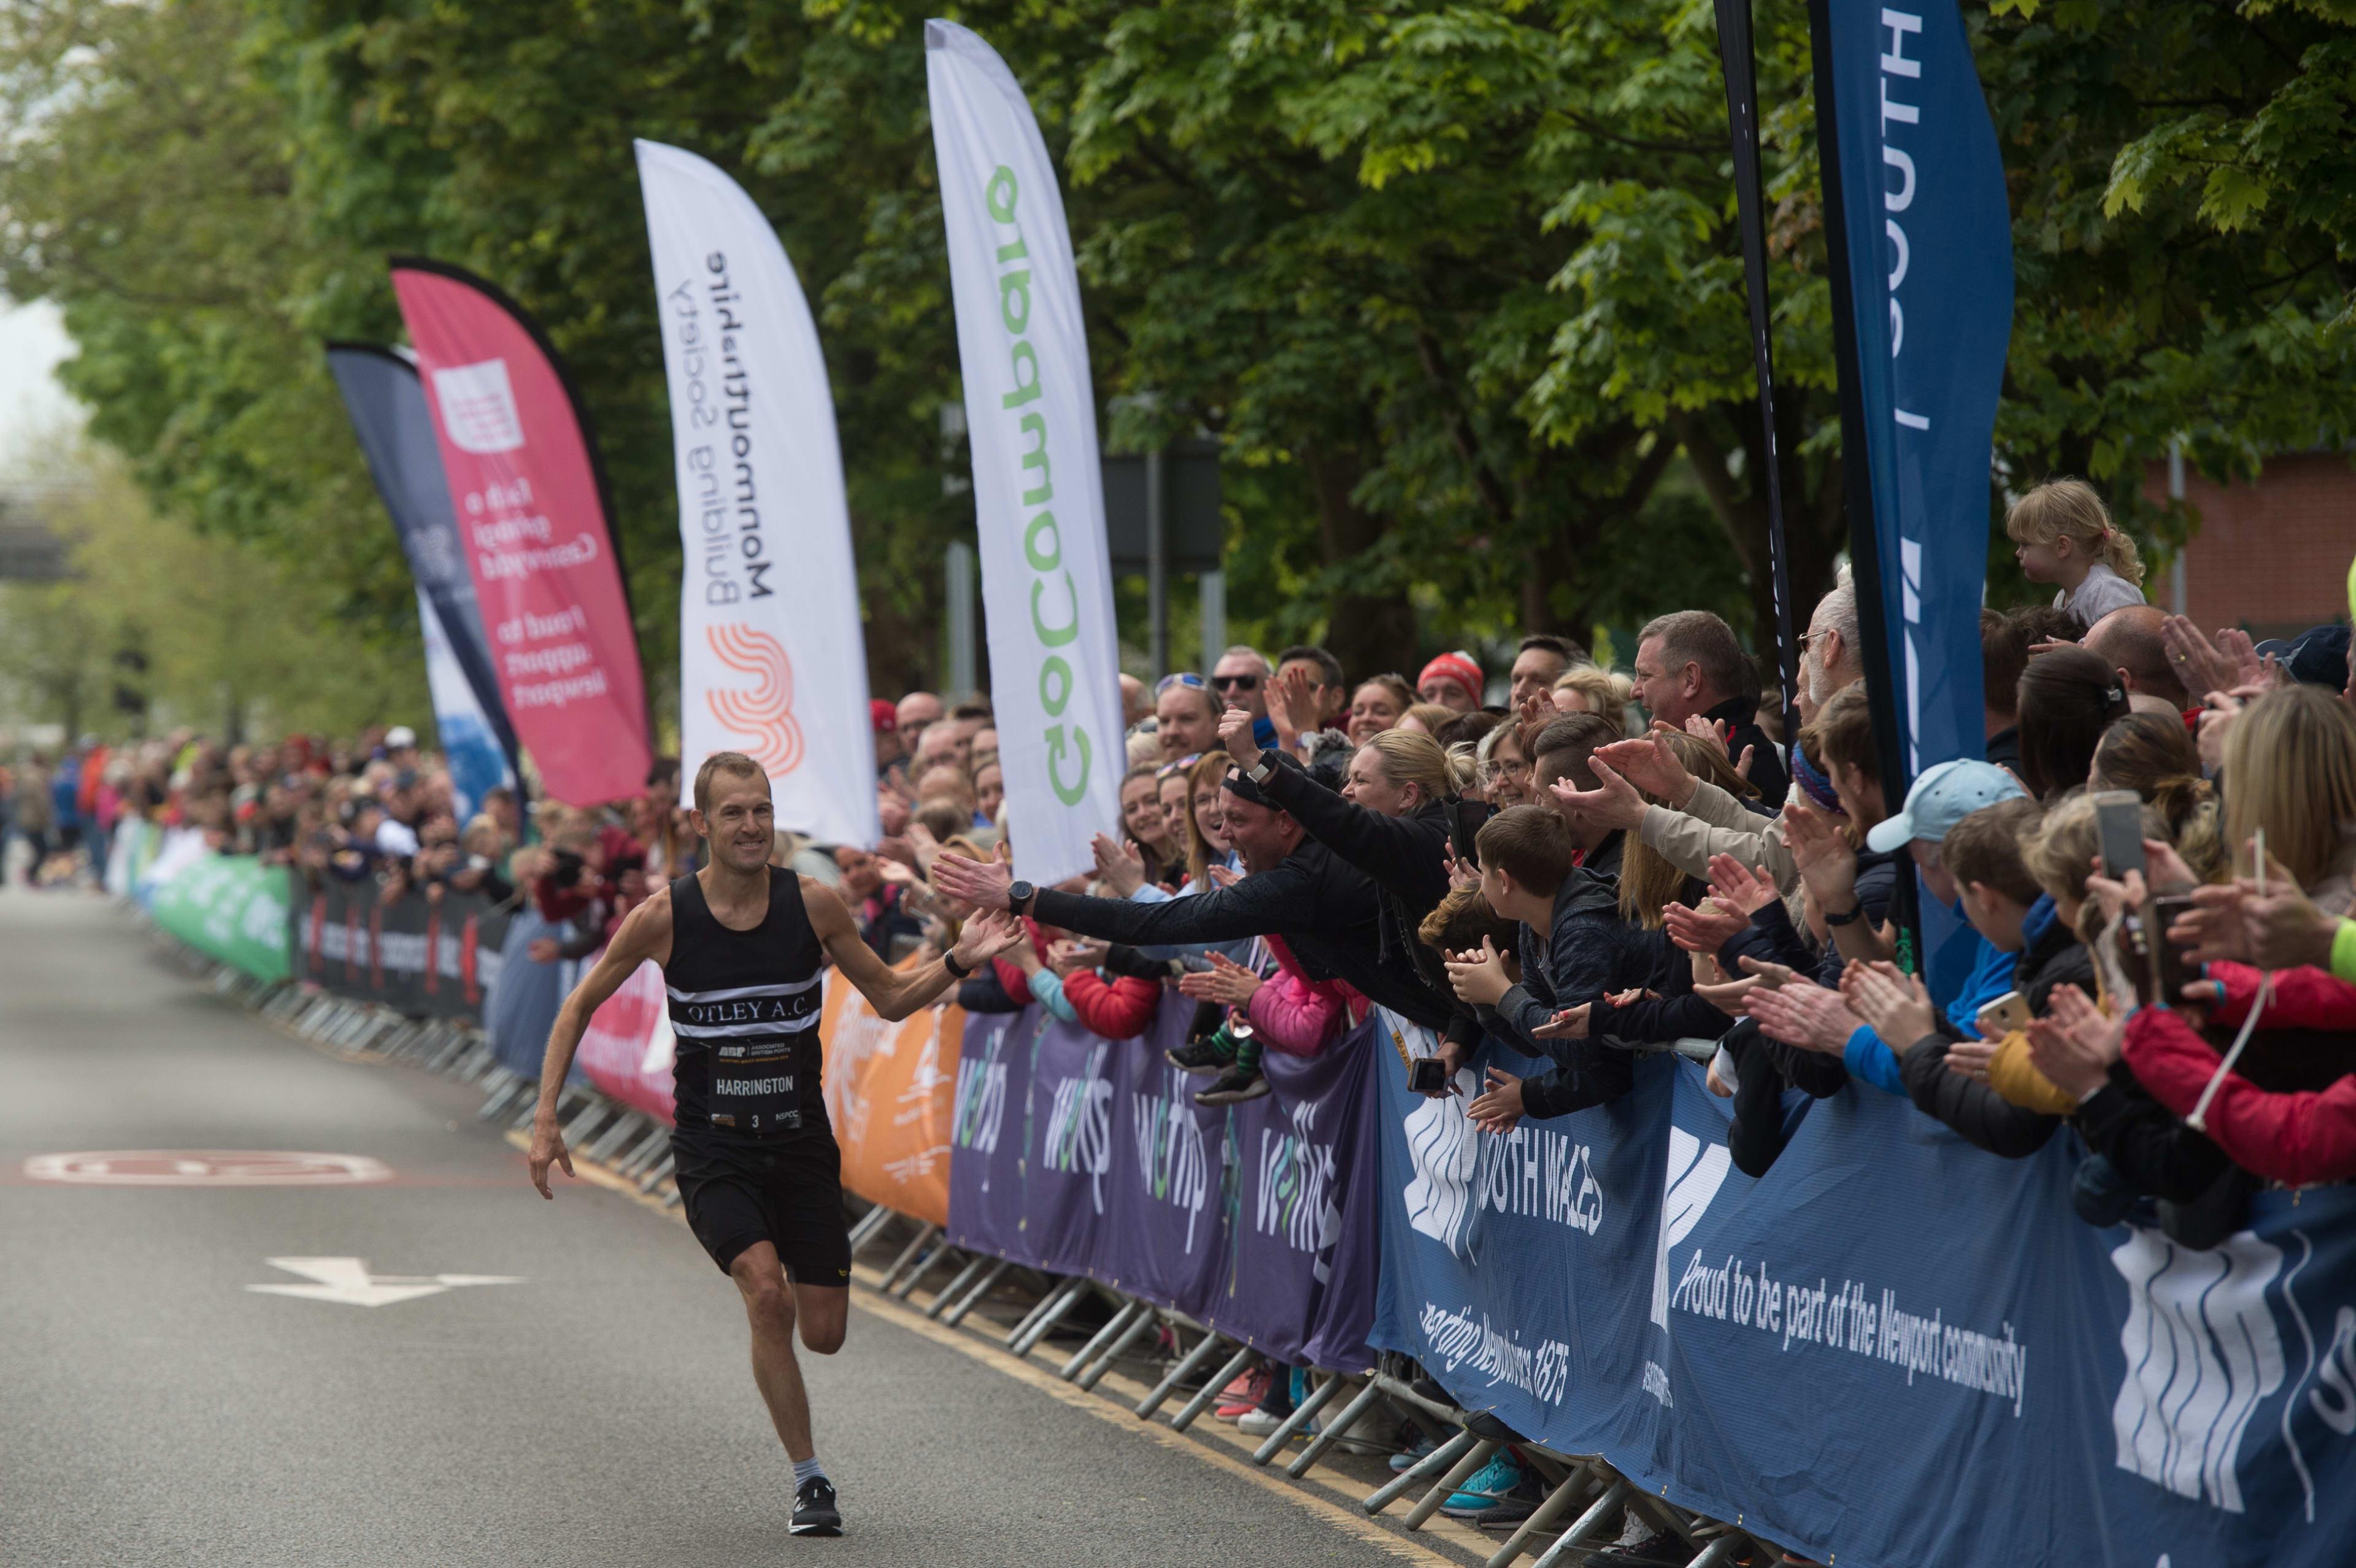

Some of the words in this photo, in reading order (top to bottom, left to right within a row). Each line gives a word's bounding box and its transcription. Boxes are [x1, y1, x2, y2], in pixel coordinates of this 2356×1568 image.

[688, 1001, 763, 1022] OTLEY
[771, 997, 808, 1017] A.C.
[717, 1075, 793, 1096] HARRINGTON
[752, 1115, 759, 1128] 3
[776, 1110, 799, 1120] NSPCC
[1671, 1248, 1733, 1320] Proud
[1733, 1260, 1753, 1325] to
[1756, 1261, 1781, 1332] be
[1783, 1278, 1826, 1351] part
[1826, 1280, 1850, 1347] of
[1849, 1283, 1876, 1356] the
[1877, 1288, 1941, 1386] Newport
[1941, 1321, 2026, 1418] community
[1534, 1339, 1569, 1407] 1875
